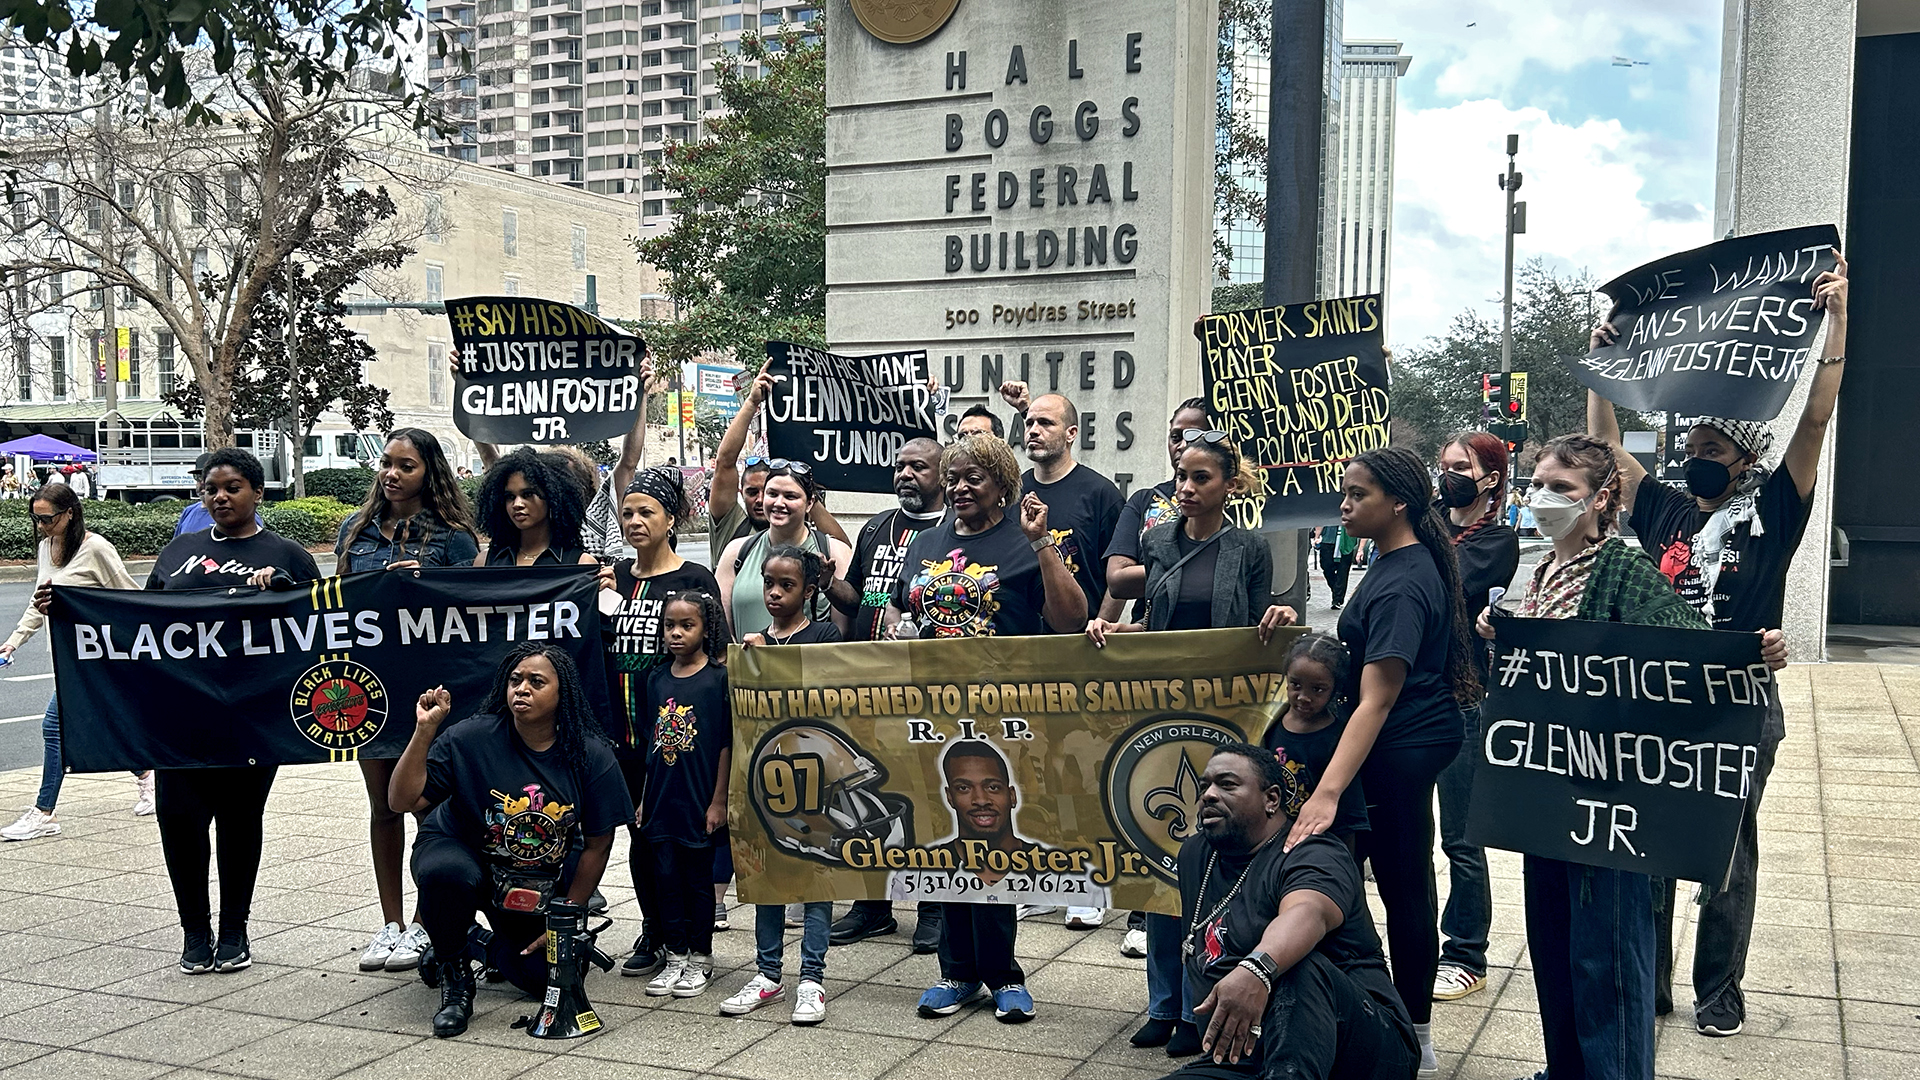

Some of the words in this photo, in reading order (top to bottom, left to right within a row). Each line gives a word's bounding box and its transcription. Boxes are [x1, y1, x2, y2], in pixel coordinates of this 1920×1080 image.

[946, 32, 1142, 90] HALE
[945, 97, 1141, 151] BOGGS
[946, 161, 1139, 213] FEDERAL
[945, 223, 1138, 273] BUILDING
[1627, 269, 1685, 306] WE
[1709, 244, 1833, 294] WANT
[455, 304, 517, 336] #SAY
[520, 304, 567, 337] HIS
[566, 307, 611, 336] NA
[946, 306, 980, 330] 500
[992, 301, 1068, 327] Poydras
[1077, 298, 1136, 320] Street
[1204, 305, 1296, 350] FORMER
[1303, 298, 1378, 338] SAINTS
[1627, 296, 1814, 350] ANSWERS
[463, 341, 578, 373] #JUSTICE
[585, 339, 637, 368] FOR
[787, 345, 833, 377] #SAY
[833, 355, 860, 381] HIS
[861, 354, 928, 386] NAME
[944, 350, 1136, 392] UNITED
[1207, 344, 1284, 381] PLAYER
[461, 379, 548, 416] GLENN
[550, 375, 639, 414] FOSTER
[768, 375, 852, 423] GLENN
[851, 383, 935, 432] FOSTER
[1212, 375, 1280, 412] GLENN
[1291, 356, 1367, 402] FOSTER
[532, 416, 571, 441] JR.
[943, 411, 1135, 451] SAES
[1207, 412, 1255, 443] WAS
[1262, 399, 1328, 438] FOUND
[1333, 387, 1389, 430] DEAD
[1257, 431, 1319, 467] POLICE
[1323, 421, 1391, 462] CUSTODY
[1282, 467, 1303, 497] A
[1309, 462, 1346, 494] TRA
[871, 560, 904, 577] LIV
[874, 545, 907, 562] BLA
[863, 577, 898, 593] MAT
[926, 576, 952, 597] BLACK
[958, 577, 978, 598] LIVES
[1675, 588, 1699, 596] Police
[75, 620, 225, 660] BLACK
[241, 609, 383, 654] LIVES
[400, 601, 582, 644] MATTER
[614, 617, 659, 635] IVES
[929, 606, 971, 623] MATTER
[295, 666, 332, 706] BLACK
[343, 666, 382, 700] LIVES
[1498, 647, 1692, 704] #JUSTICE
[1703, 664, 1771, 706] FOR
[734, 687, 782, 719] WHAT
[787, 685, 924, 718] HAPPENED
[927, 684, 961, 715] TO
[967, 681, 1080, 715] FORMER
[1085, 677, 1187, 712] SAINTS
[307, 721, 377, 746] MATTER
[909, 721, 945, 741] R.
[959, 720, 987, 740] I.
[1001, 720, 1034, 739] P.
[1134, 730, 1163, 753] NEW
[1169, 727, 1233, 745] ORLEAN
[1485, 719, 1607, 781] GLENN
[763, 758, 820, 813] 97
[507, 815, 531, 836] BLACK
[1570, 798, 1646, 858] JR.
[510, 843, 551, 857] MATTER
[842, 837, 956, 869] Glenn
[961, 839, 1088, 872] Foster
[1093, 841, 1148, 884] Jr.
[905, 871, 984, 895] 5/31/90
[1005, 874, 1088, 894] 12/6/21
